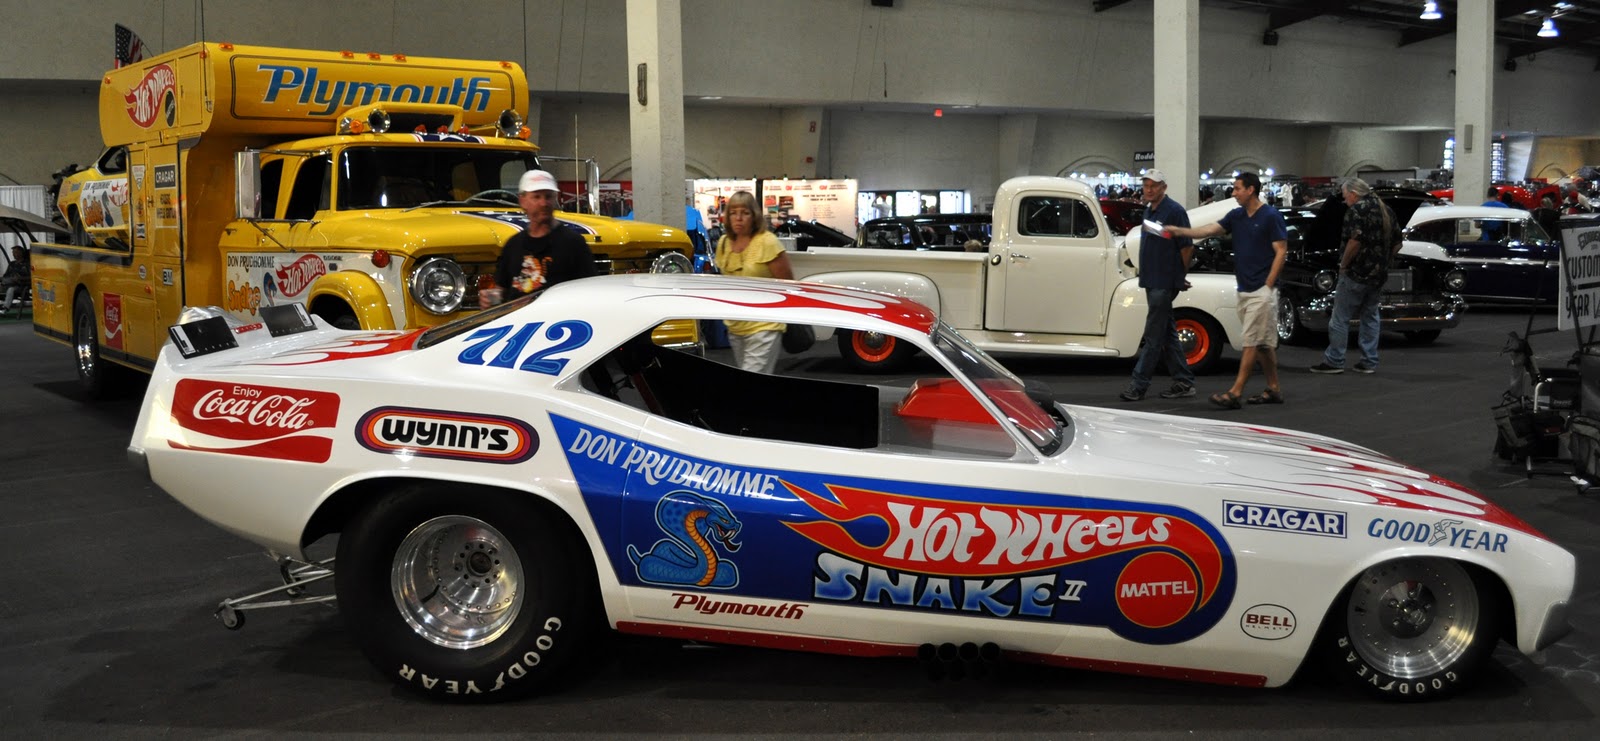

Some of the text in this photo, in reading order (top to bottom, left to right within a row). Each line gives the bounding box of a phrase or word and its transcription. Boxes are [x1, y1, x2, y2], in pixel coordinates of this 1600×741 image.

[257, 64, 490, 116] Plymouth
[155, 170, 175, 183] CRAGAR
[228, 255, 239, 268] DON
[458, 320, 593, 376] 712
[233, 386, 262, 397] Enjoy
[193, 389, 316, 429] Coca-Cola
[568, 428, 779, 500] DON PRUDHOMME
[1228, 504, 1341, 534] CRAGAR
[813, 552, 1087, 618] SNAKE II
[1121, 579, 1195, 598] MATTEL
[671, 592, 808, 620] Plymouth
[1246, 613, 1292, 628] BELL
